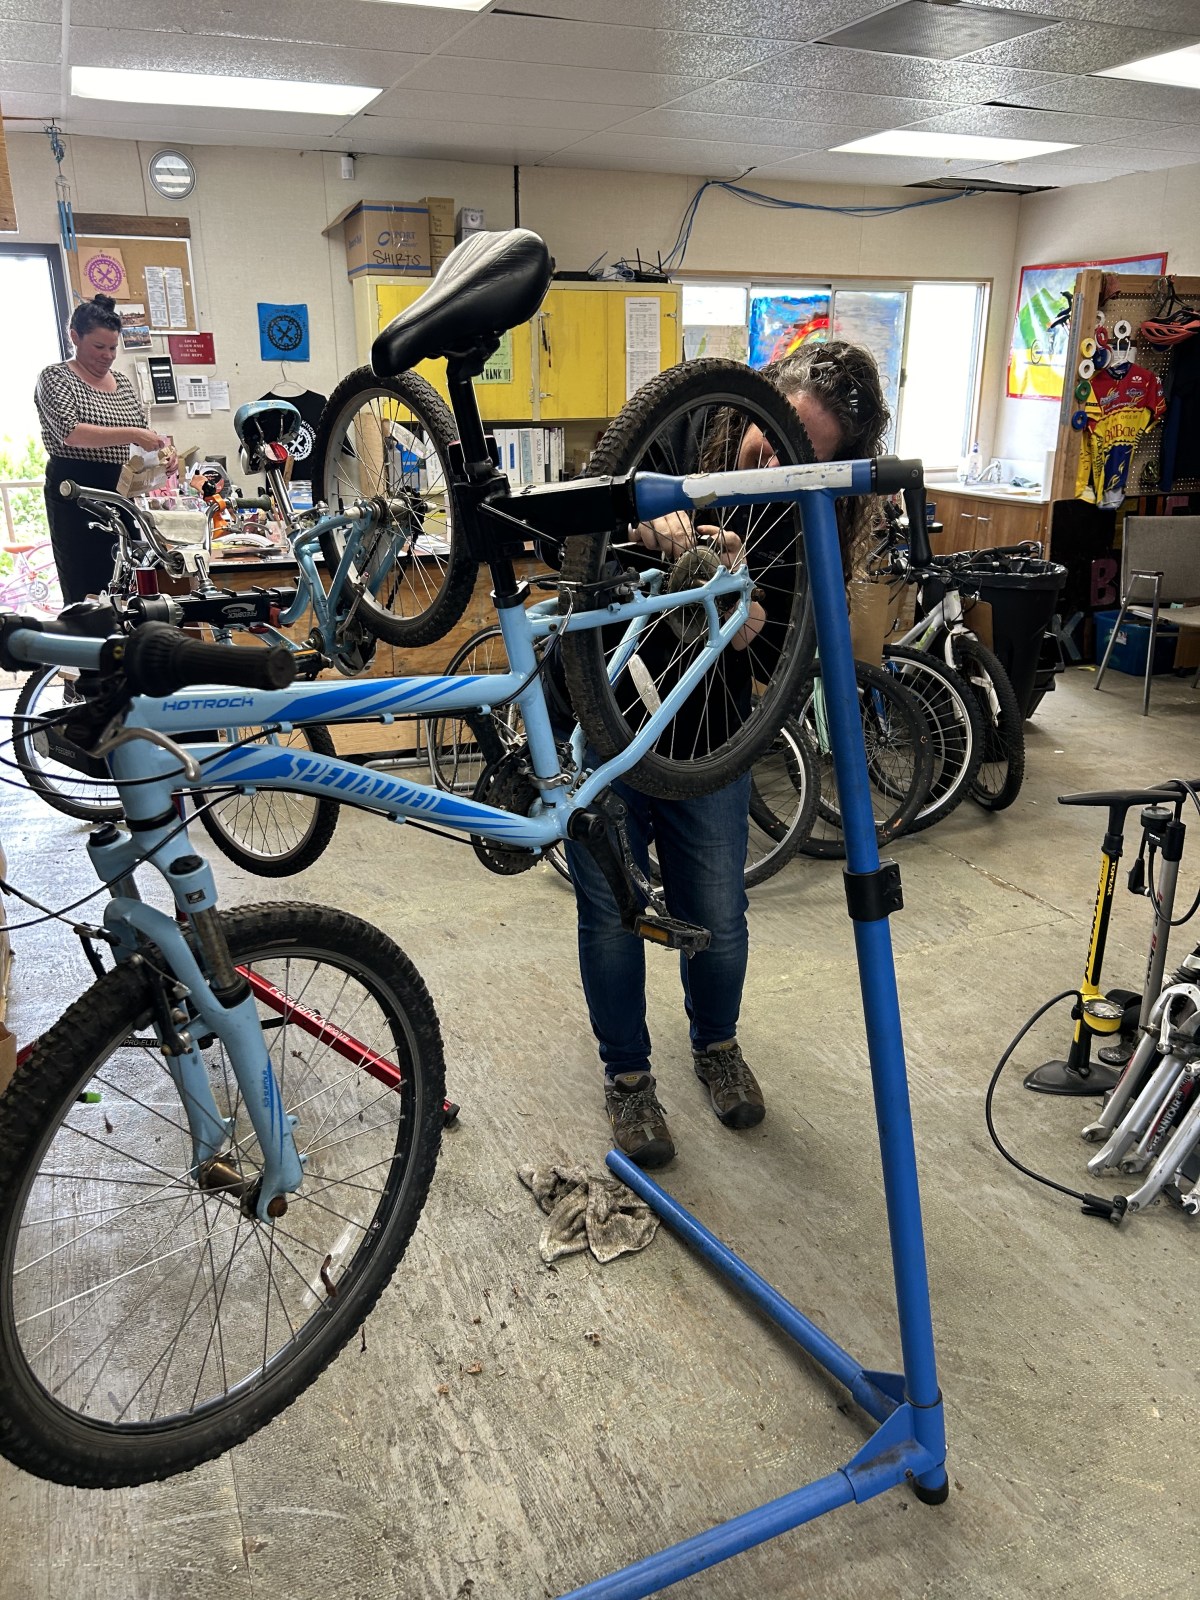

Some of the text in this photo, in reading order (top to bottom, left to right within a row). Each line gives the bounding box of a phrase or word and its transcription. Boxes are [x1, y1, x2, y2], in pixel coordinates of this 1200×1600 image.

[372, 249, 422, 267] SHIRTS
[301, 419, 317, 443] KITCHE
[162, 696, 255, 712] HOTROCK
[276, 754, 442, 812] SPECIALIZED
[1106, 861, 1117, 897] TOPEAK
[268, 986, 327, 1027] FEEDBACK
[123, 1039, 139, 1047] PRO
[1157, 1099, 1183, 1138] SUNTOUR
